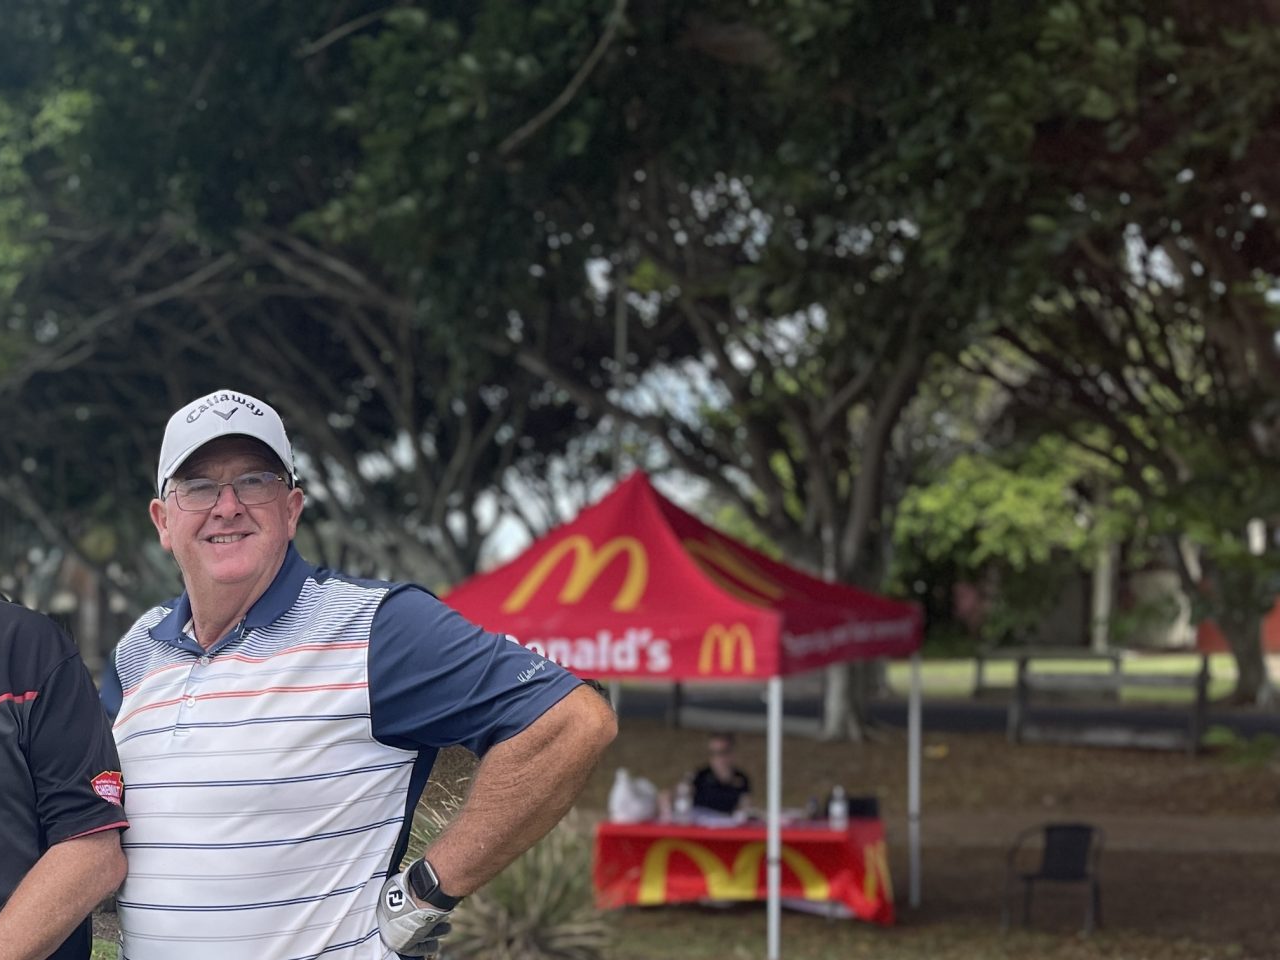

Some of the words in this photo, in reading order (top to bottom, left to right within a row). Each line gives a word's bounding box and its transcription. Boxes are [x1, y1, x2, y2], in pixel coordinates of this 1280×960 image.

[186, 393, 264, 424] Callaway
[505, 628, 671, 673] onald's
[388, 889, 403, 907] FJ
